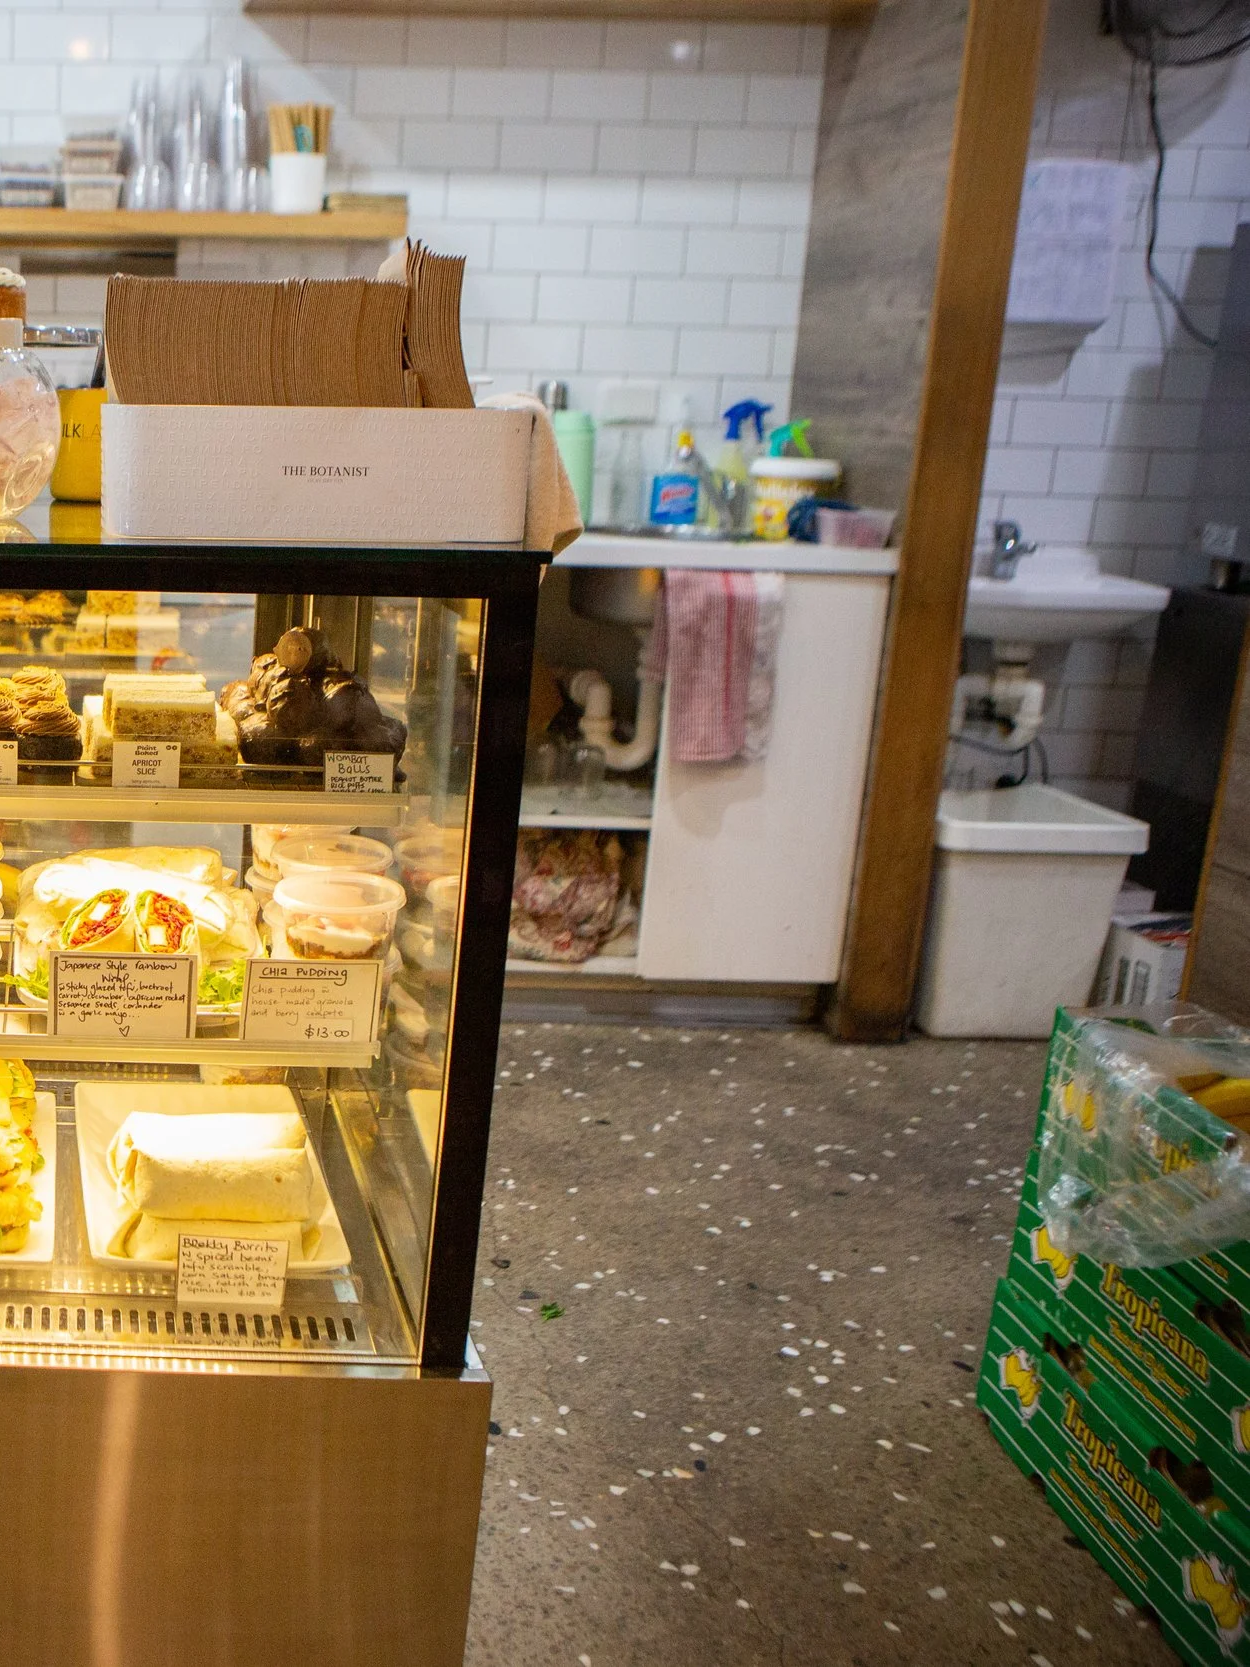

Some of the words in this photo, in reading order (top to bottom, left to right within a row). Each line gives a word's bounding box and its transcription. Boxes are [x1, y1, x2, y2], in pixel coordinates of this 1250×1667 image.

[282, 466, 306, 476] THE
[310, 466, 370, 476] BOTANIST
[132, 759, 162, 767] APRICOT
[59, 961, 101, 972] Japanese
[1103, 1262, 1209, 1385] Tropicana
[1063, 1391, 1161, 1529] Tropicana
